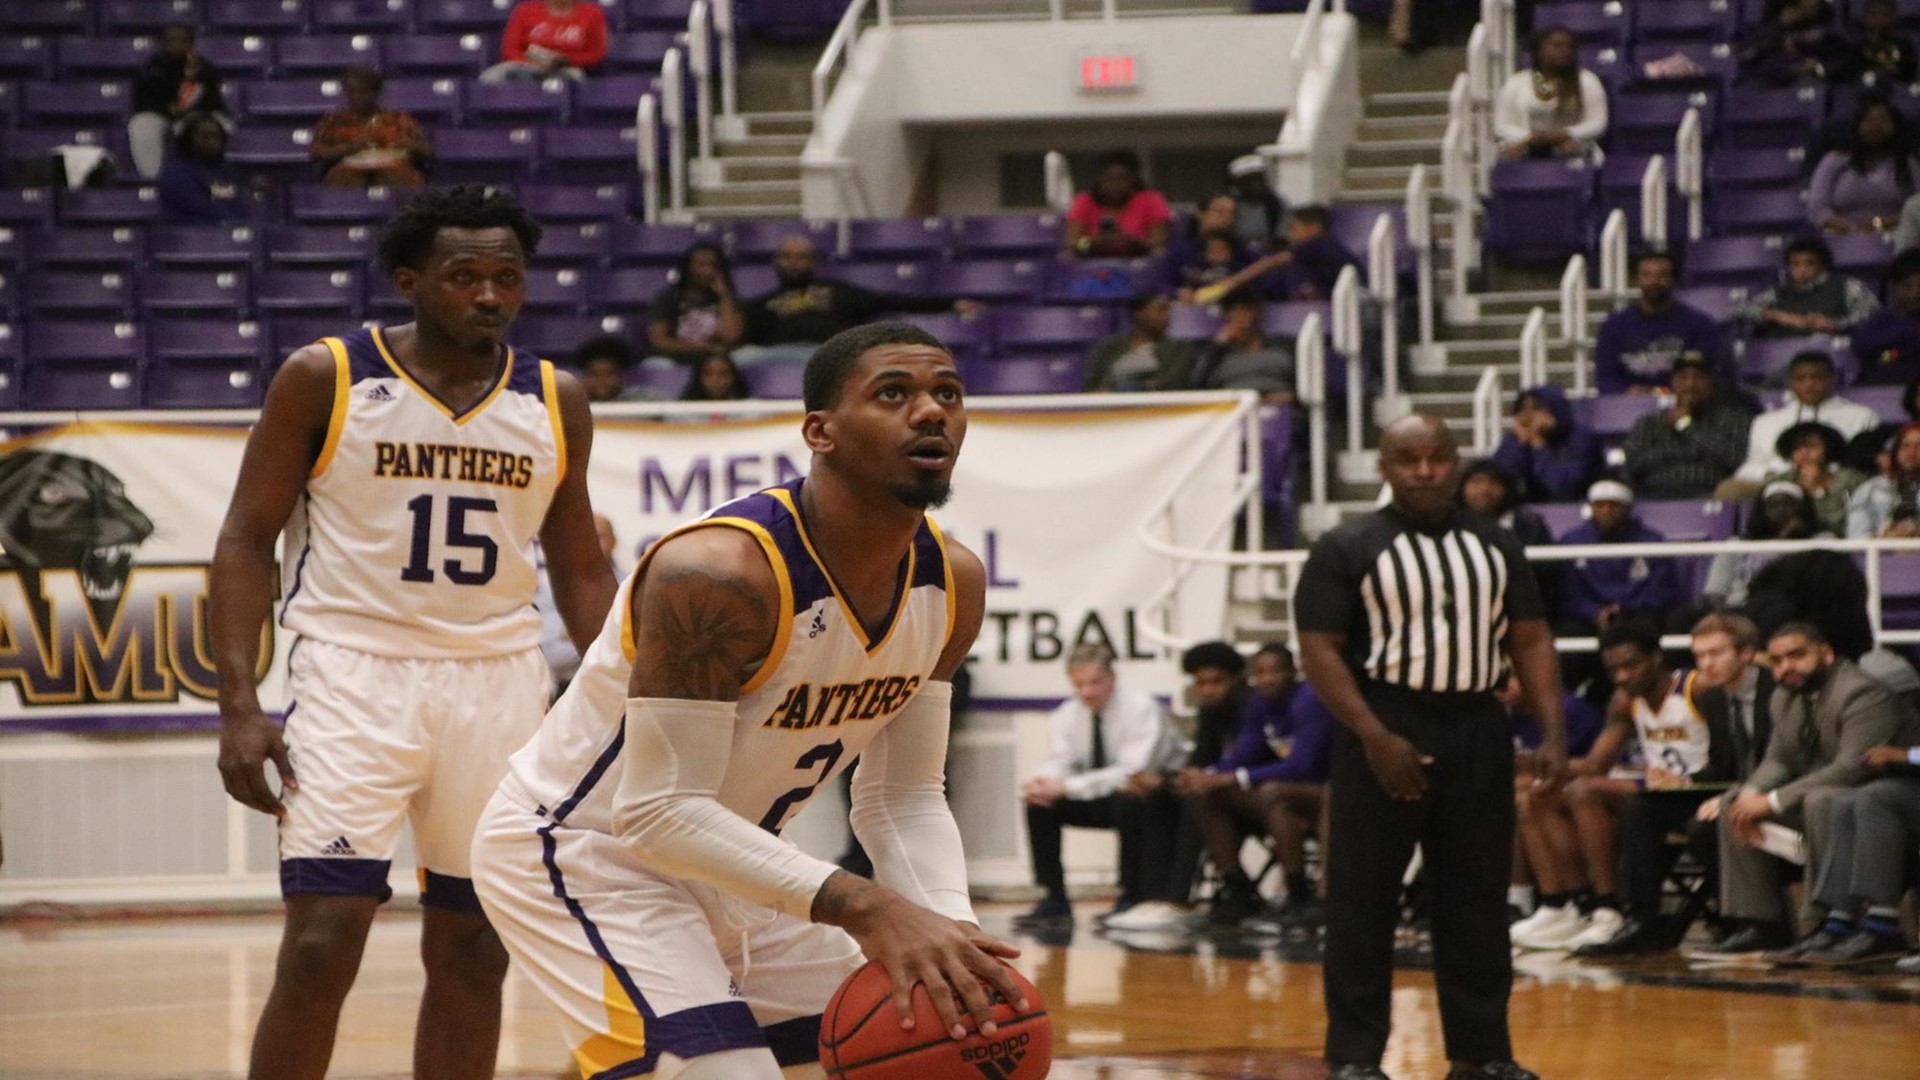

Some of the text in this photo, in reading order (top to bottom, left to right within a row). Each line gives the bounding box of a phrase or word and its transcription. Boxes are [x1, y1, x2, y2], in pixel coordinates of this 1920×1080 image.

[1081, 54, 1136, 87] EXIT
[374, 440, 534, 490] PANTHERS
[401, 493, 499, 586] 15
[763, 675, 920, 729] PANTHERS
[757, 737, 845, 837] 2
[960, 1031, 1030, 1063] adidas
